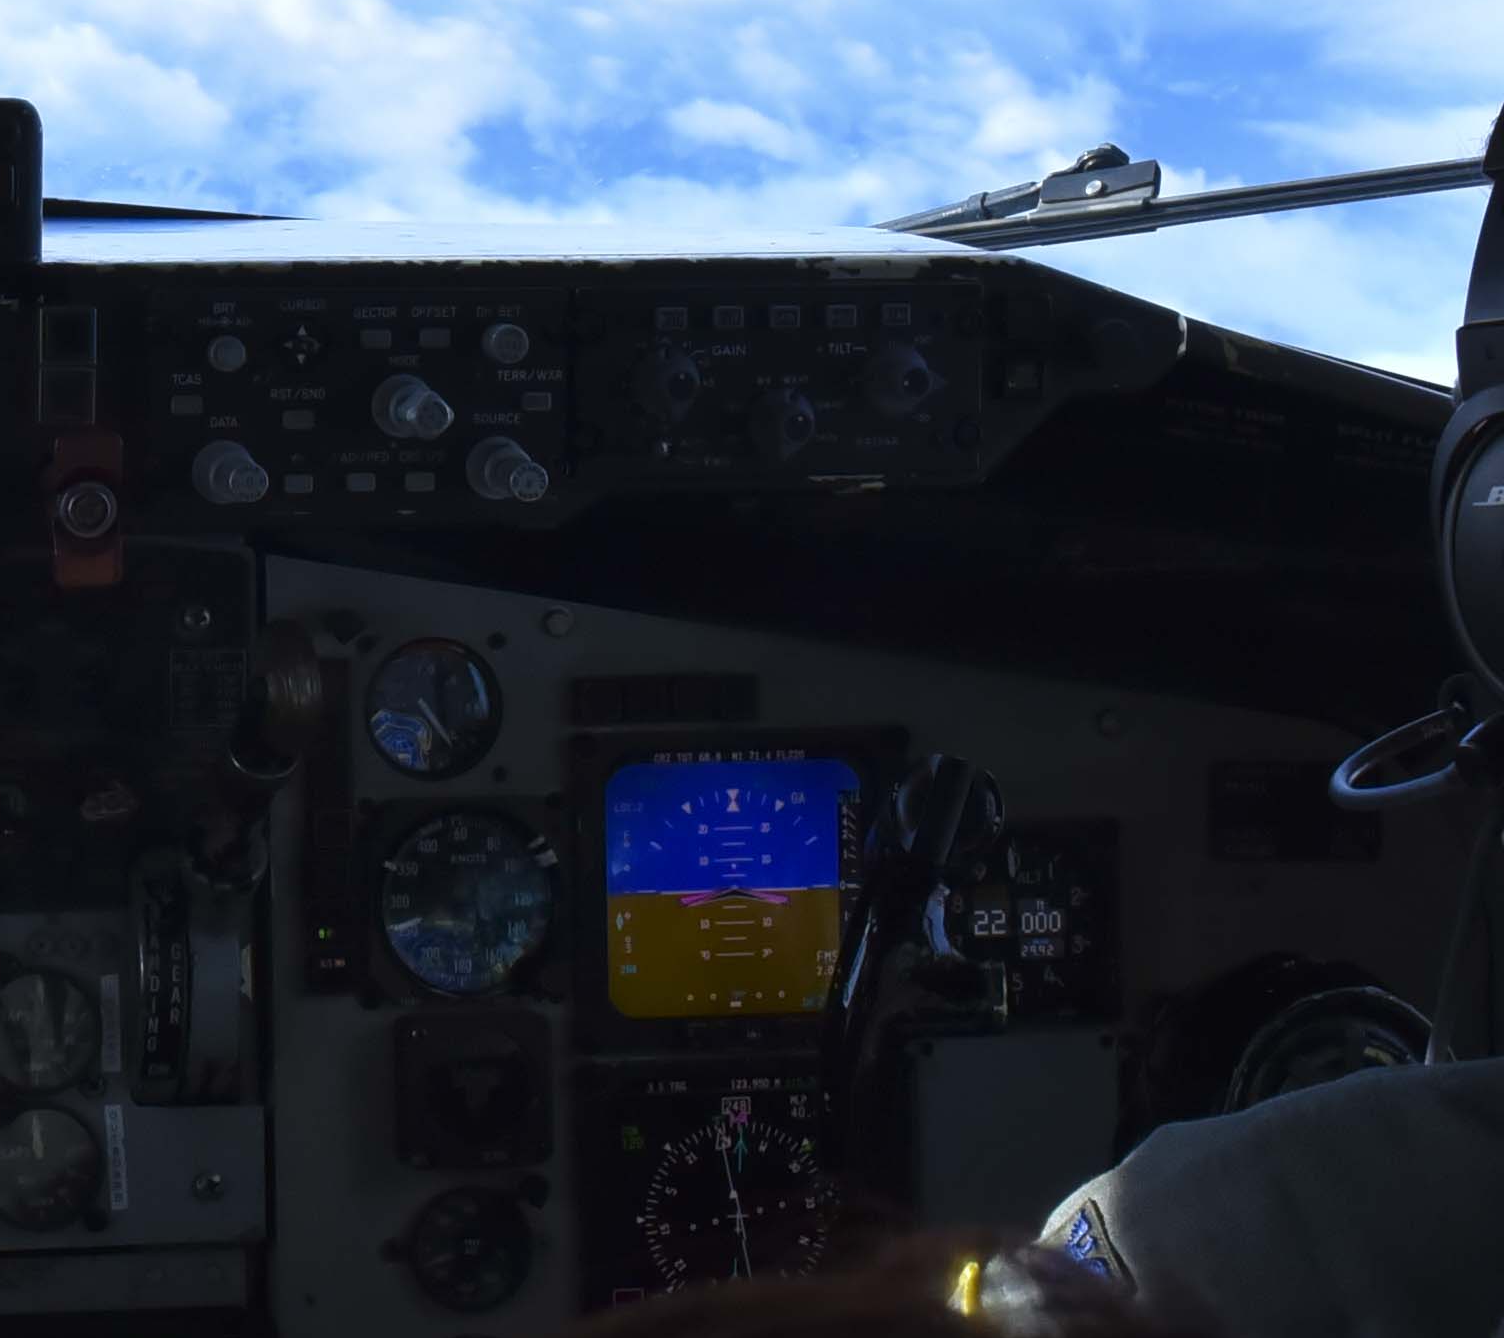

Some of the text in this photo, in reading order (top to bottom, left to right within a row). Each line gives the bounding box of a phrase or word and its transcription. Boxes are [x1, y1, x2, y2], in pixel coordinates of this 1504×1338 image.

[170, 373, 202, 386] TCAS
[472, 412, 521, 425] SOURCE
[974, 910, 1061, 935] 22 000
[816, 950, 839, 963] FMS
[169, 941, 183, 1025] GEAR
